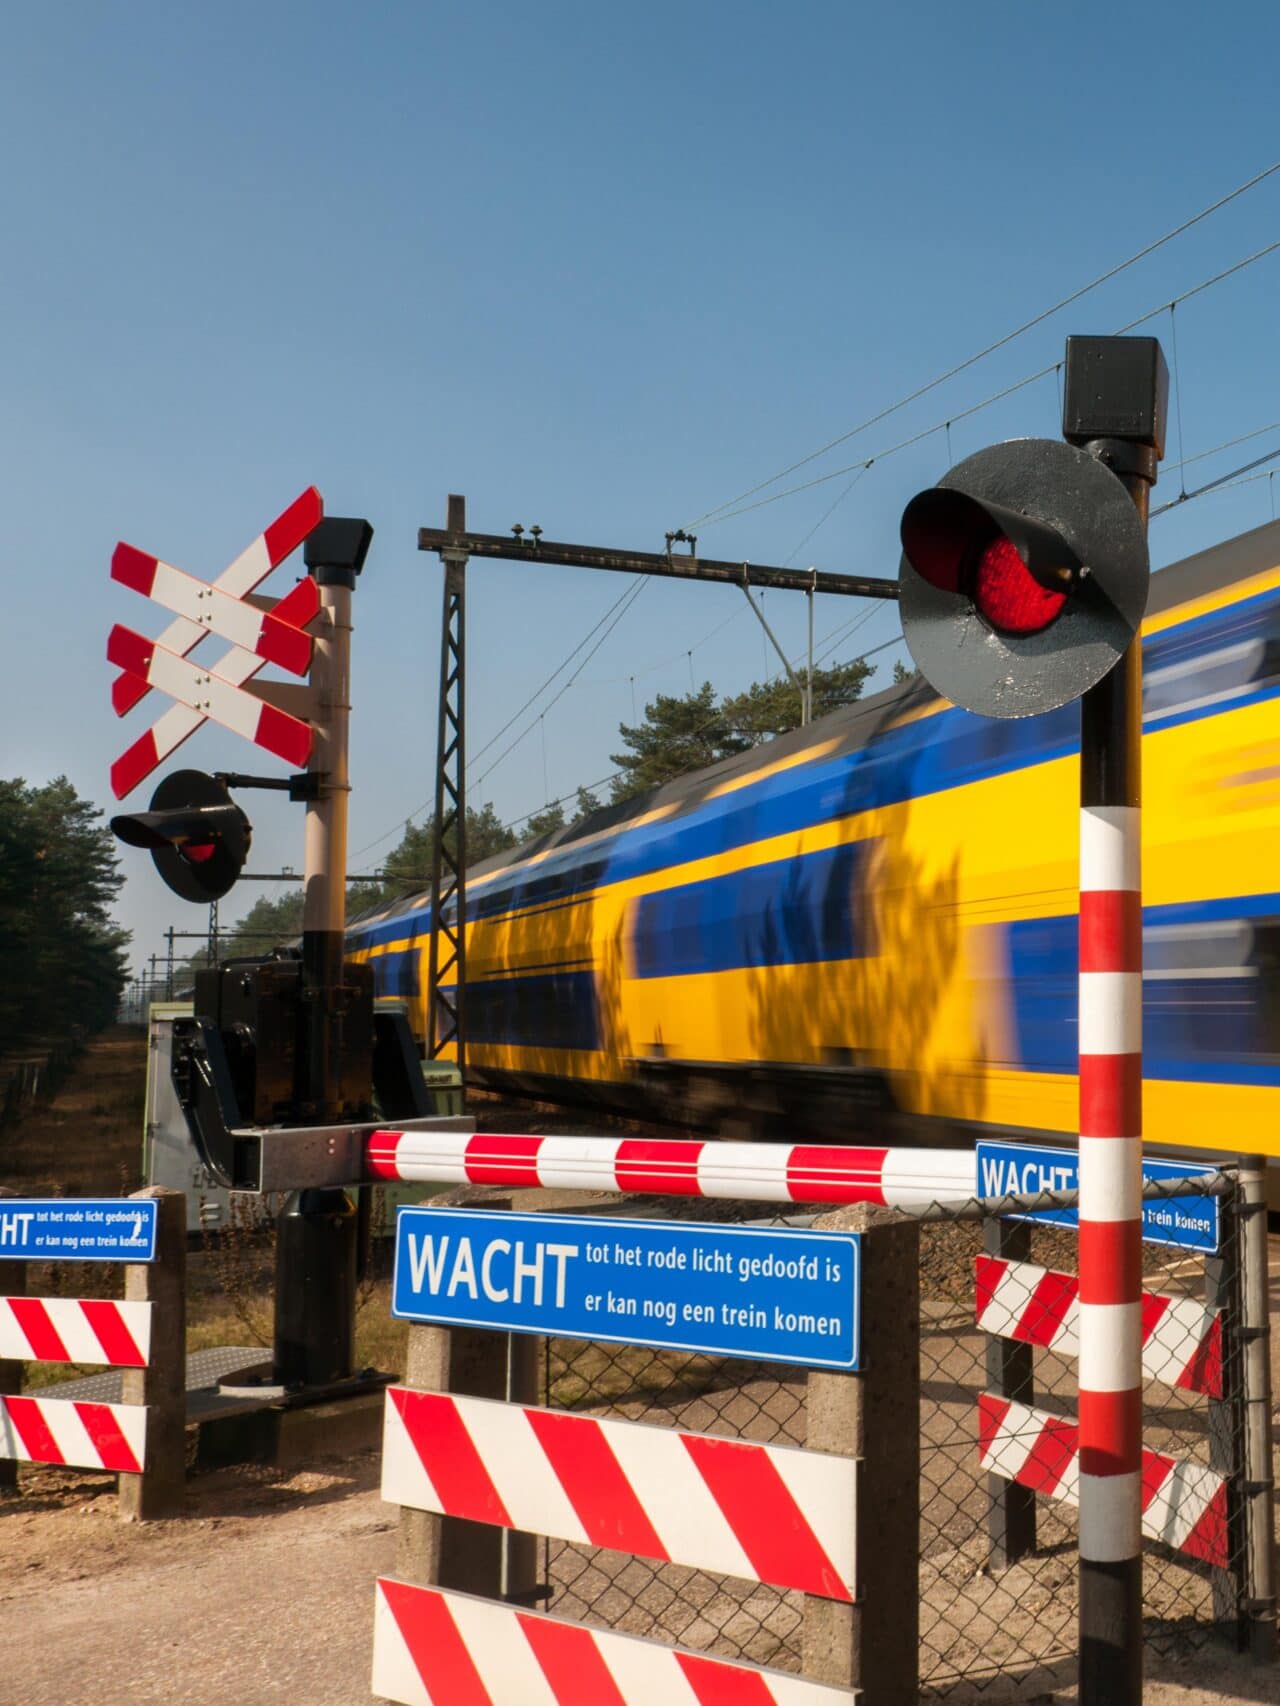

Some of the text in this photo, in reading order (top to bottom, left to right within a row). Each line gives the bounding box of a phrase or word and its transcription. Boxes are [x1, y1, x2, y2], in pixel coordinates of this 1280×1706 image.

[981, 1157, 1073, 1199] WACHT
[0, 1213, 34, 1246] HT
[36, 1211, 49, 1222] tot
[50, 1210, 64, 1222] het
[65, 1210, 84, 1222] rode
[85, 1210, 104, 1222] licht
[142, 1210, 149, 1222] is
[1147, 1208, 1172, 1226] trein
[1175, 1210, 1211, 1233] komen
[35, 1234, 148, 1250] er kan nog een trein komen
[407, 1233, 579, 1308] WACHT
[586, 1242, 841, 1282] tot het rode licht gedoofd is
[584, 1290, 841, 1336] er kan nog een trein komen
